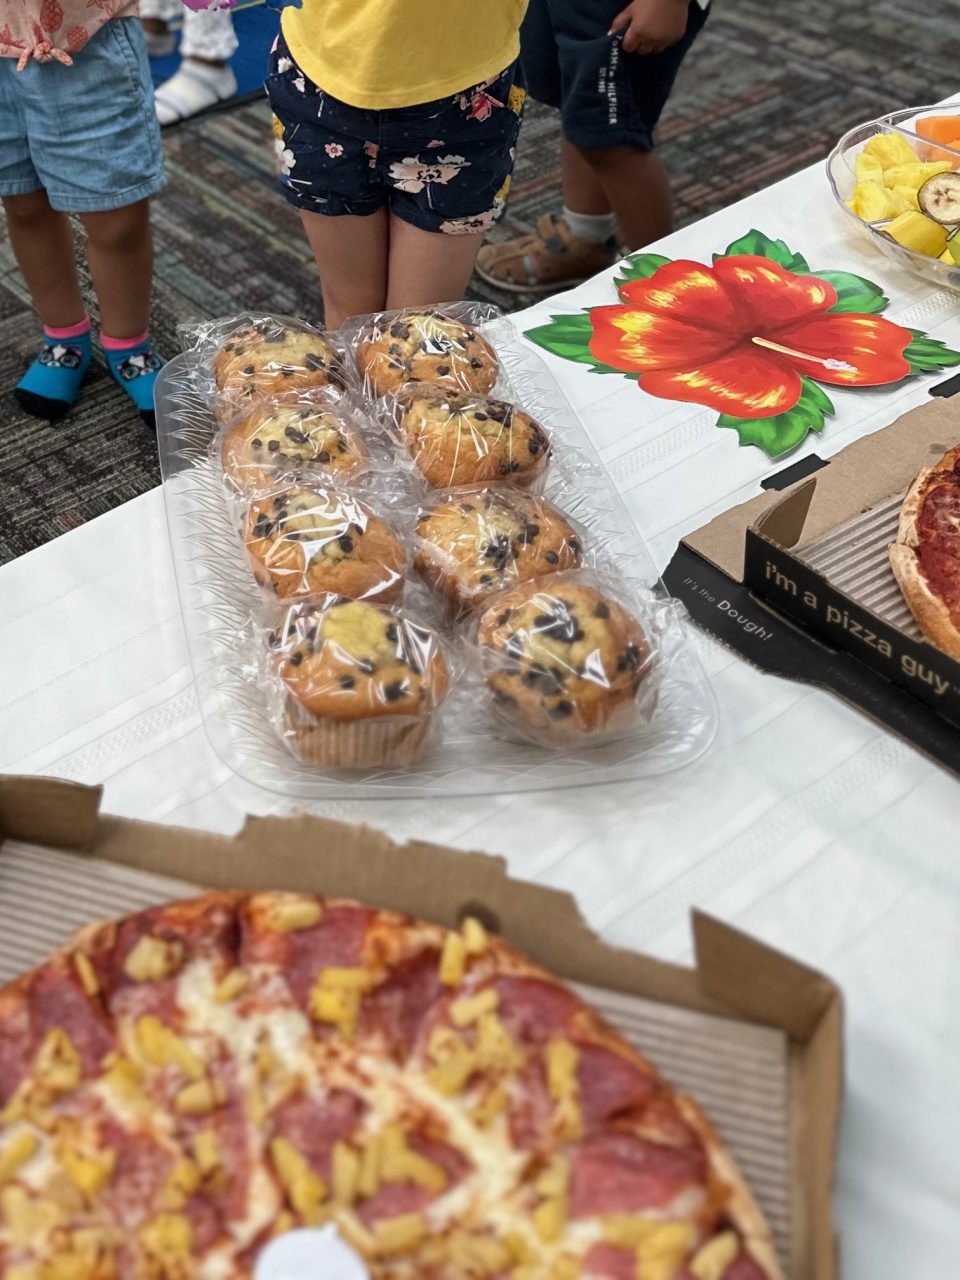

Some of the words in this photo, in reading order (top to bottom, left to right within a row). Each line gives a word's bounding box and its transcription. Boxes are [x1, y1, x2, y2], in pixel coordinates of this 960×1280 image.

[610, 35, 623, 71] TOMMY
[607, 82, 618, 125] HILFIGER
[682, 577, 699, 591] It's
[698, 589, 717, 603] the
[717, 600, 774, 641] Dough!
[765, 561, 797, 596] i'm
[803, 591, 819, 610] a
[826, 604, 893, 658] pizza
[901, 654, 950, 696] guy
